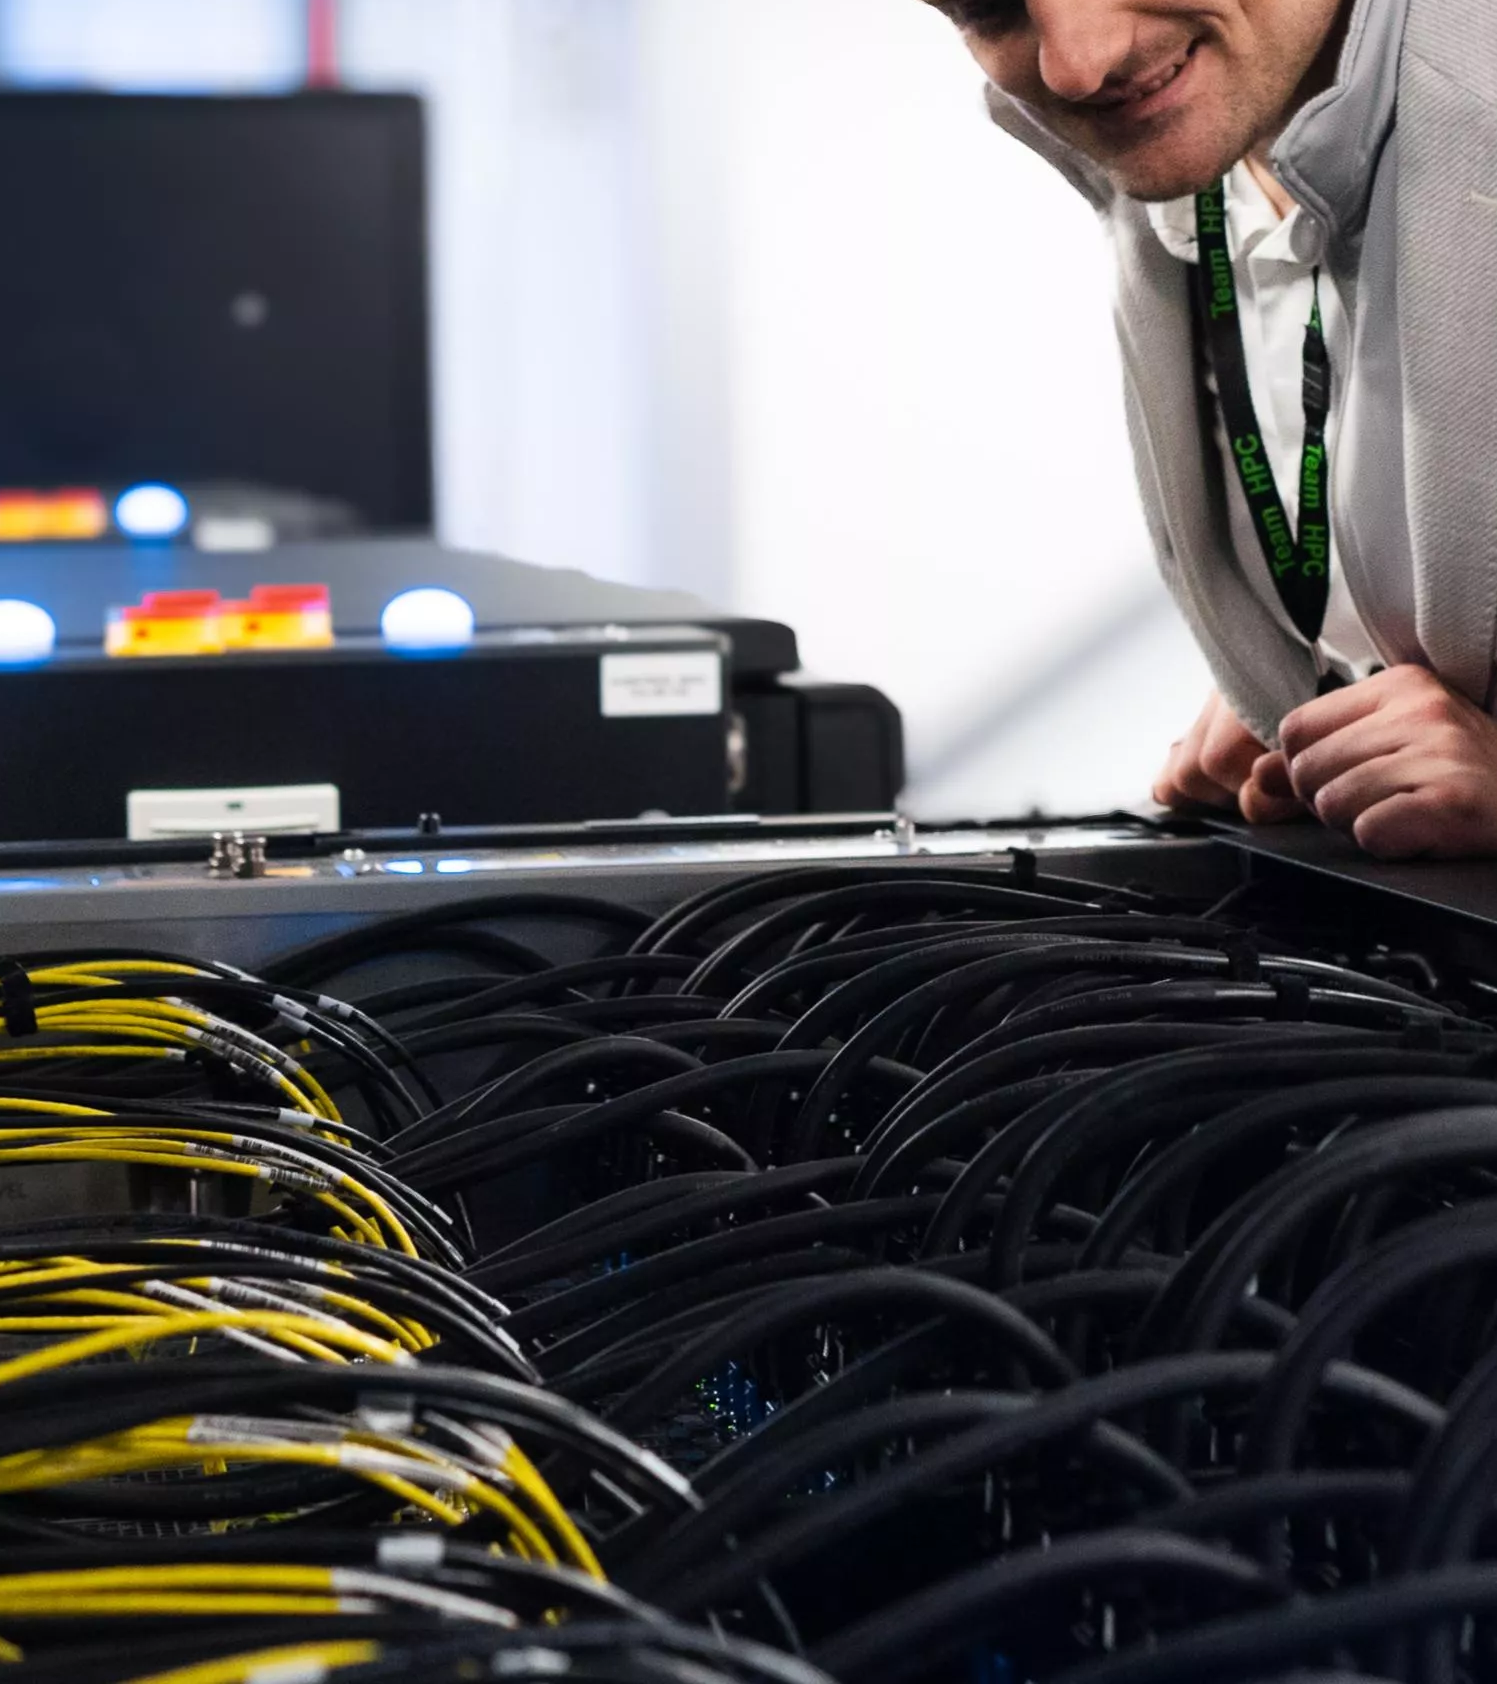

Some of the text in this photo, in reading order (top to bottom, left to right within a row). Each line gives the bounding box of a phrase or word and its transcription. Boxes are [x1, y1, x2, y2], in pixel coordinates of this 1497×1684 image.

[1210, 248, 1234, 320] Team
[1234, 433, 1295, 578] Team HPC
[1303, 444, 1326, 577] Team HPC
